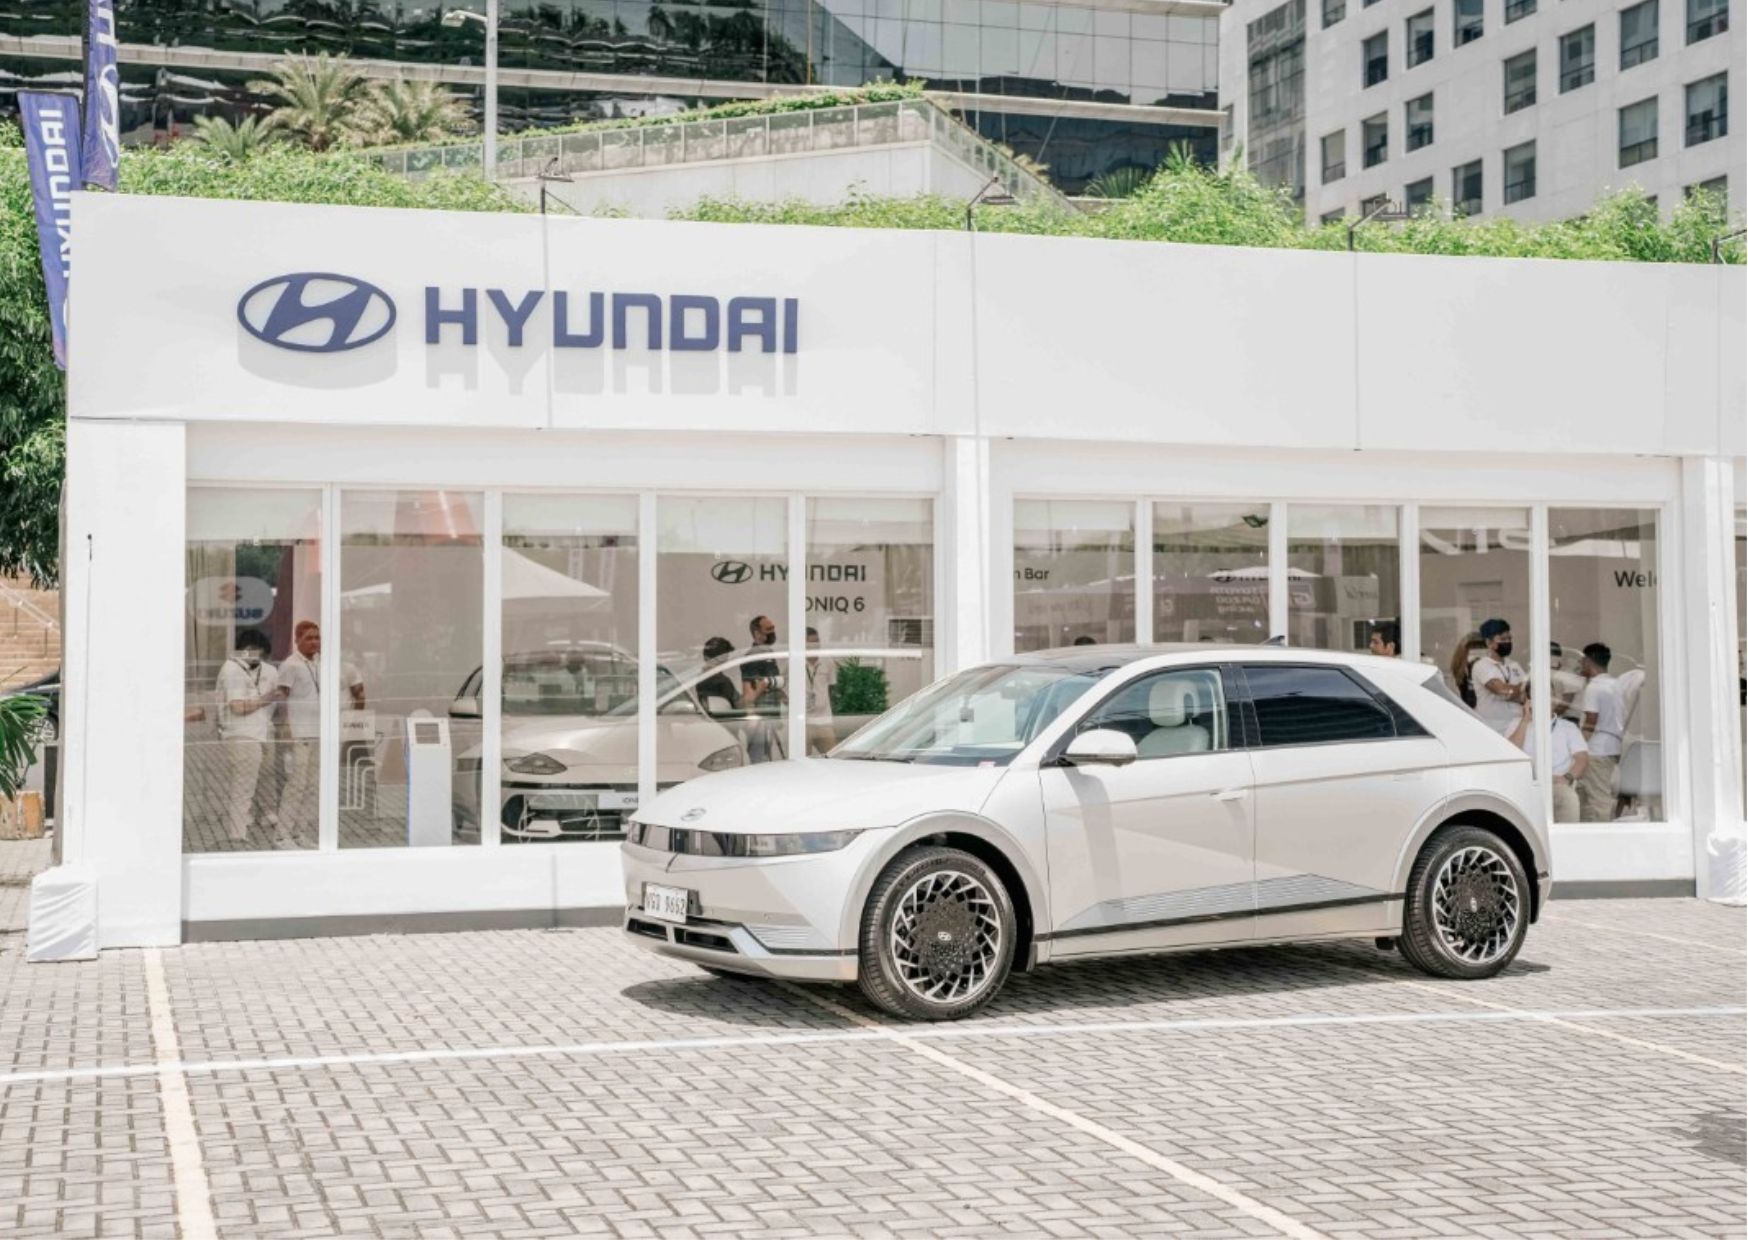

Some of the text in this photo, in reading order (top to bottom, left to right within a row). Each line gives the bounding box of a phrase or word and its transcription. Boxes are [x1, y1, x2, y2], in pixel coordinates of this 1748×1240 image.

[425, 286, 798, 354] HYUNDAI
[760, 564, 866, 582] HYNDAI
[1025, 567, 1049, 580] Bar
[806, 597, 865, 613] ONIQ 6
